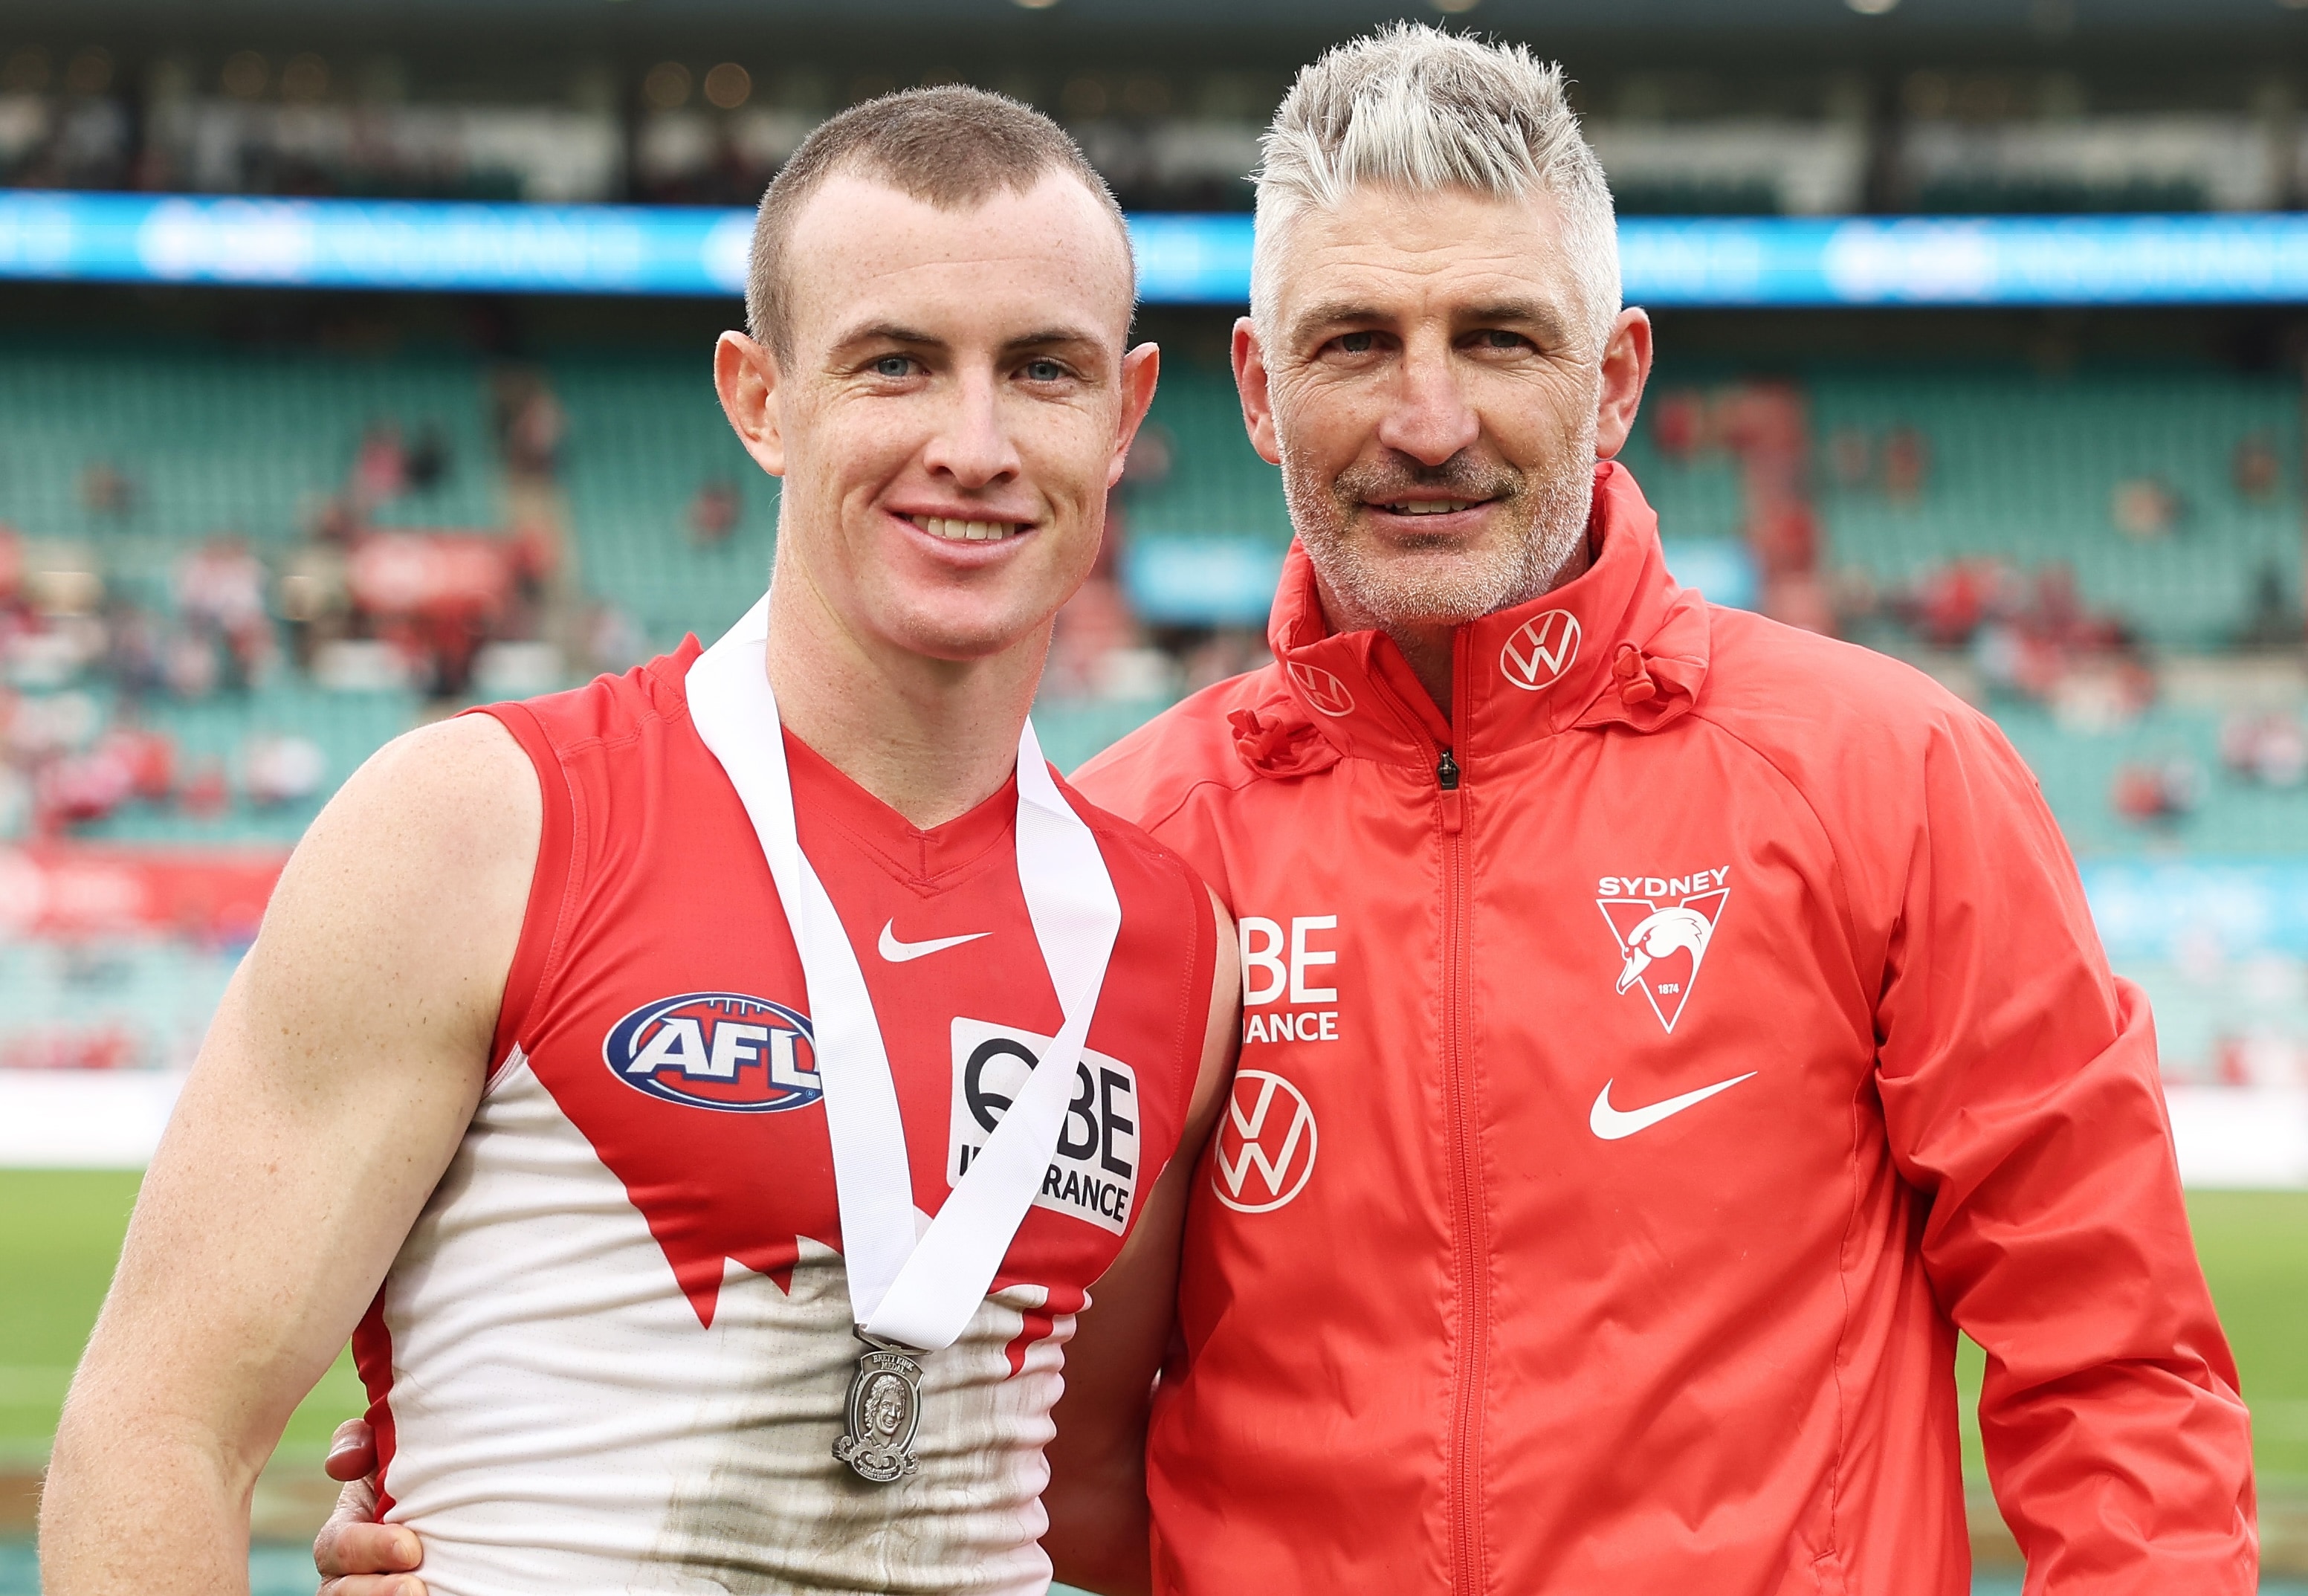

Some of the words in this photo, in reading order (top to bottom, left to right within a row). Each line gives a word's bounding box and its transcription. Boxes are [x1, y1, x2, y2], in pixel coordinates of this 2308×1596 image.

[1598, 865, 1730, 896] SYDNEY
[1238, 914, 1337, 1006] BE
[1658, 983, 1679, 994] 1874
[1243, 1012, 1339, 1044] ANCE
[626, 1017, 821, 1090] AFL
[959, 1143, 1129, 1224] IRANCE
[873, 1354, 896, 1363] BRETT
[896, 1356, 914, 1372] KIRK
